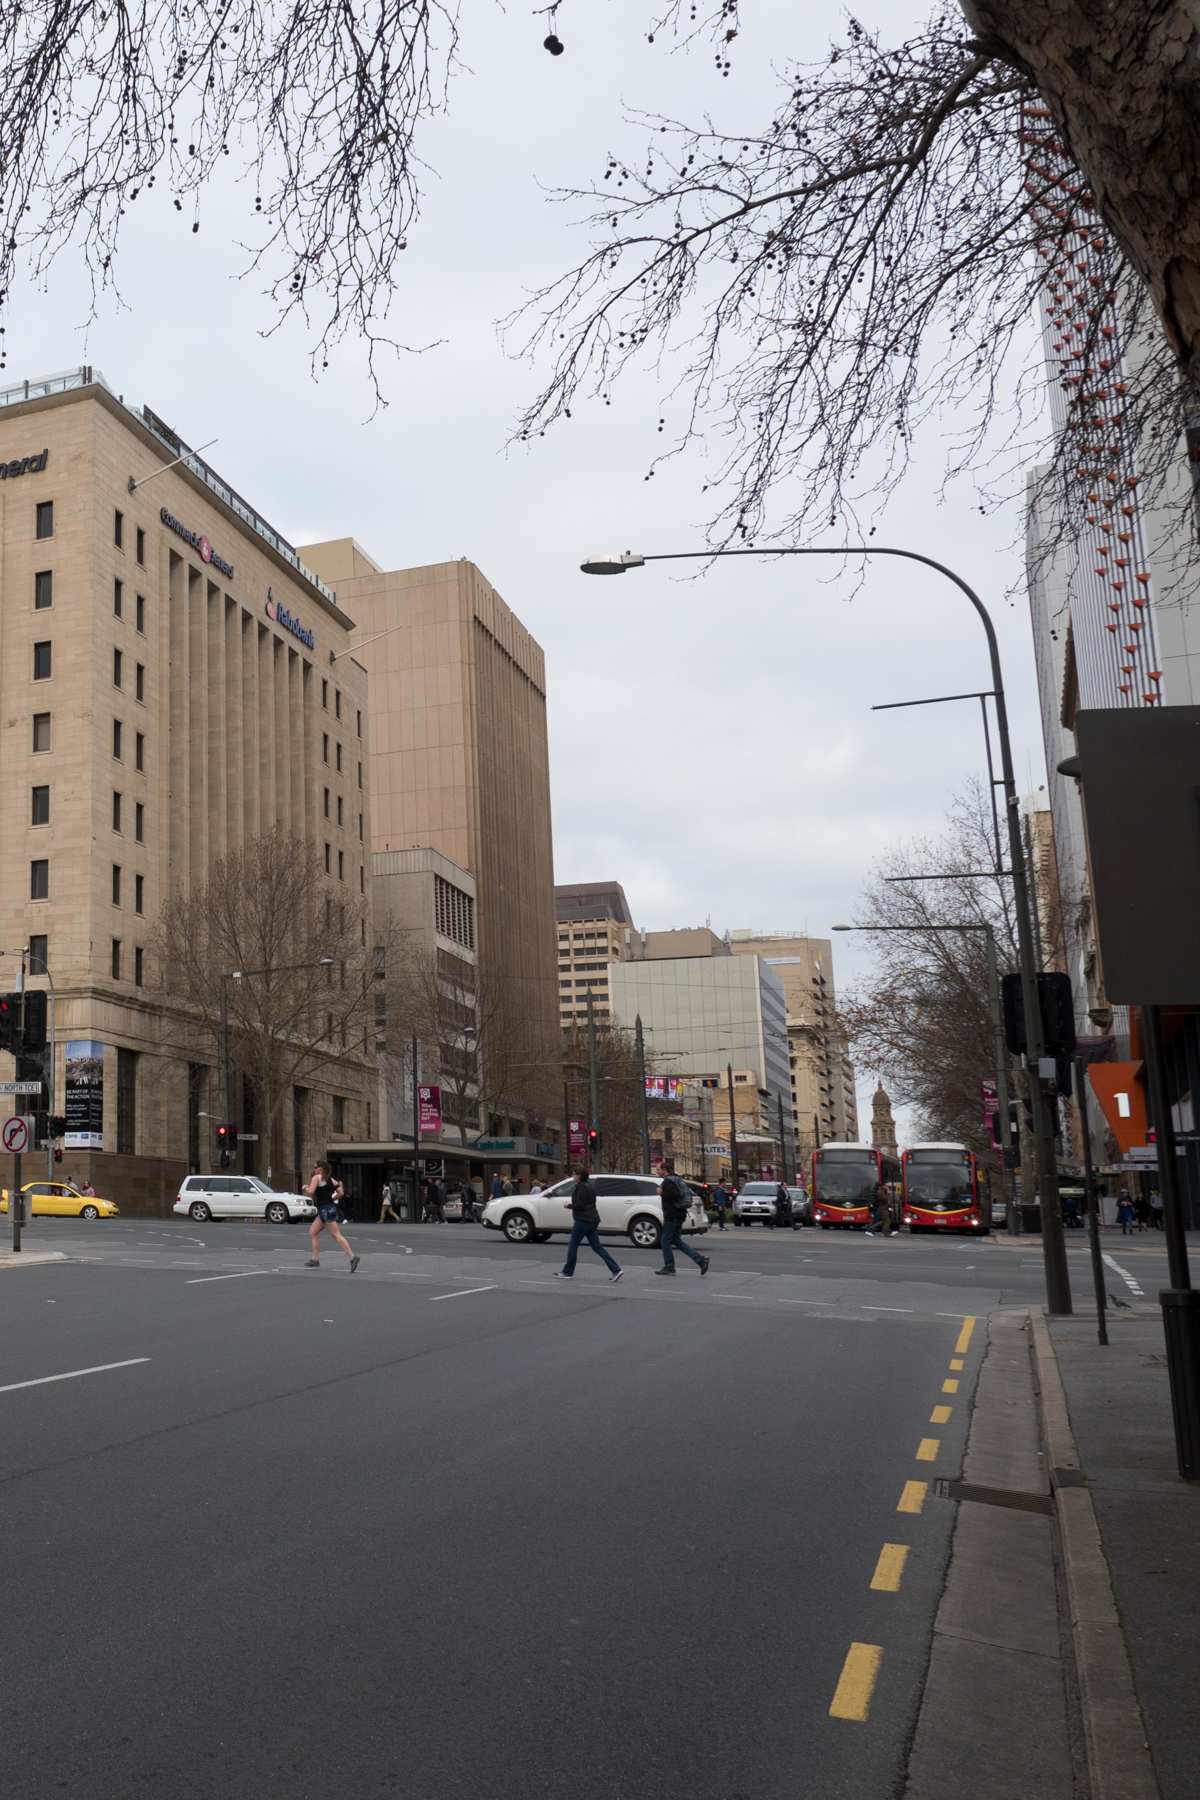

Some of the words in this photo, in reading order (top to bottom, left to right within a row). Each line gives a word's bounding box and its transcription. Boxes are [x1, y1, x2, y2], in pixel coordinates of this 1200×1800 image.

[276, 602, 315, 651] Rabobank
[4, 1084, 23, 1092] NORTH
[1113, 1092, 1131, 1118] 1
